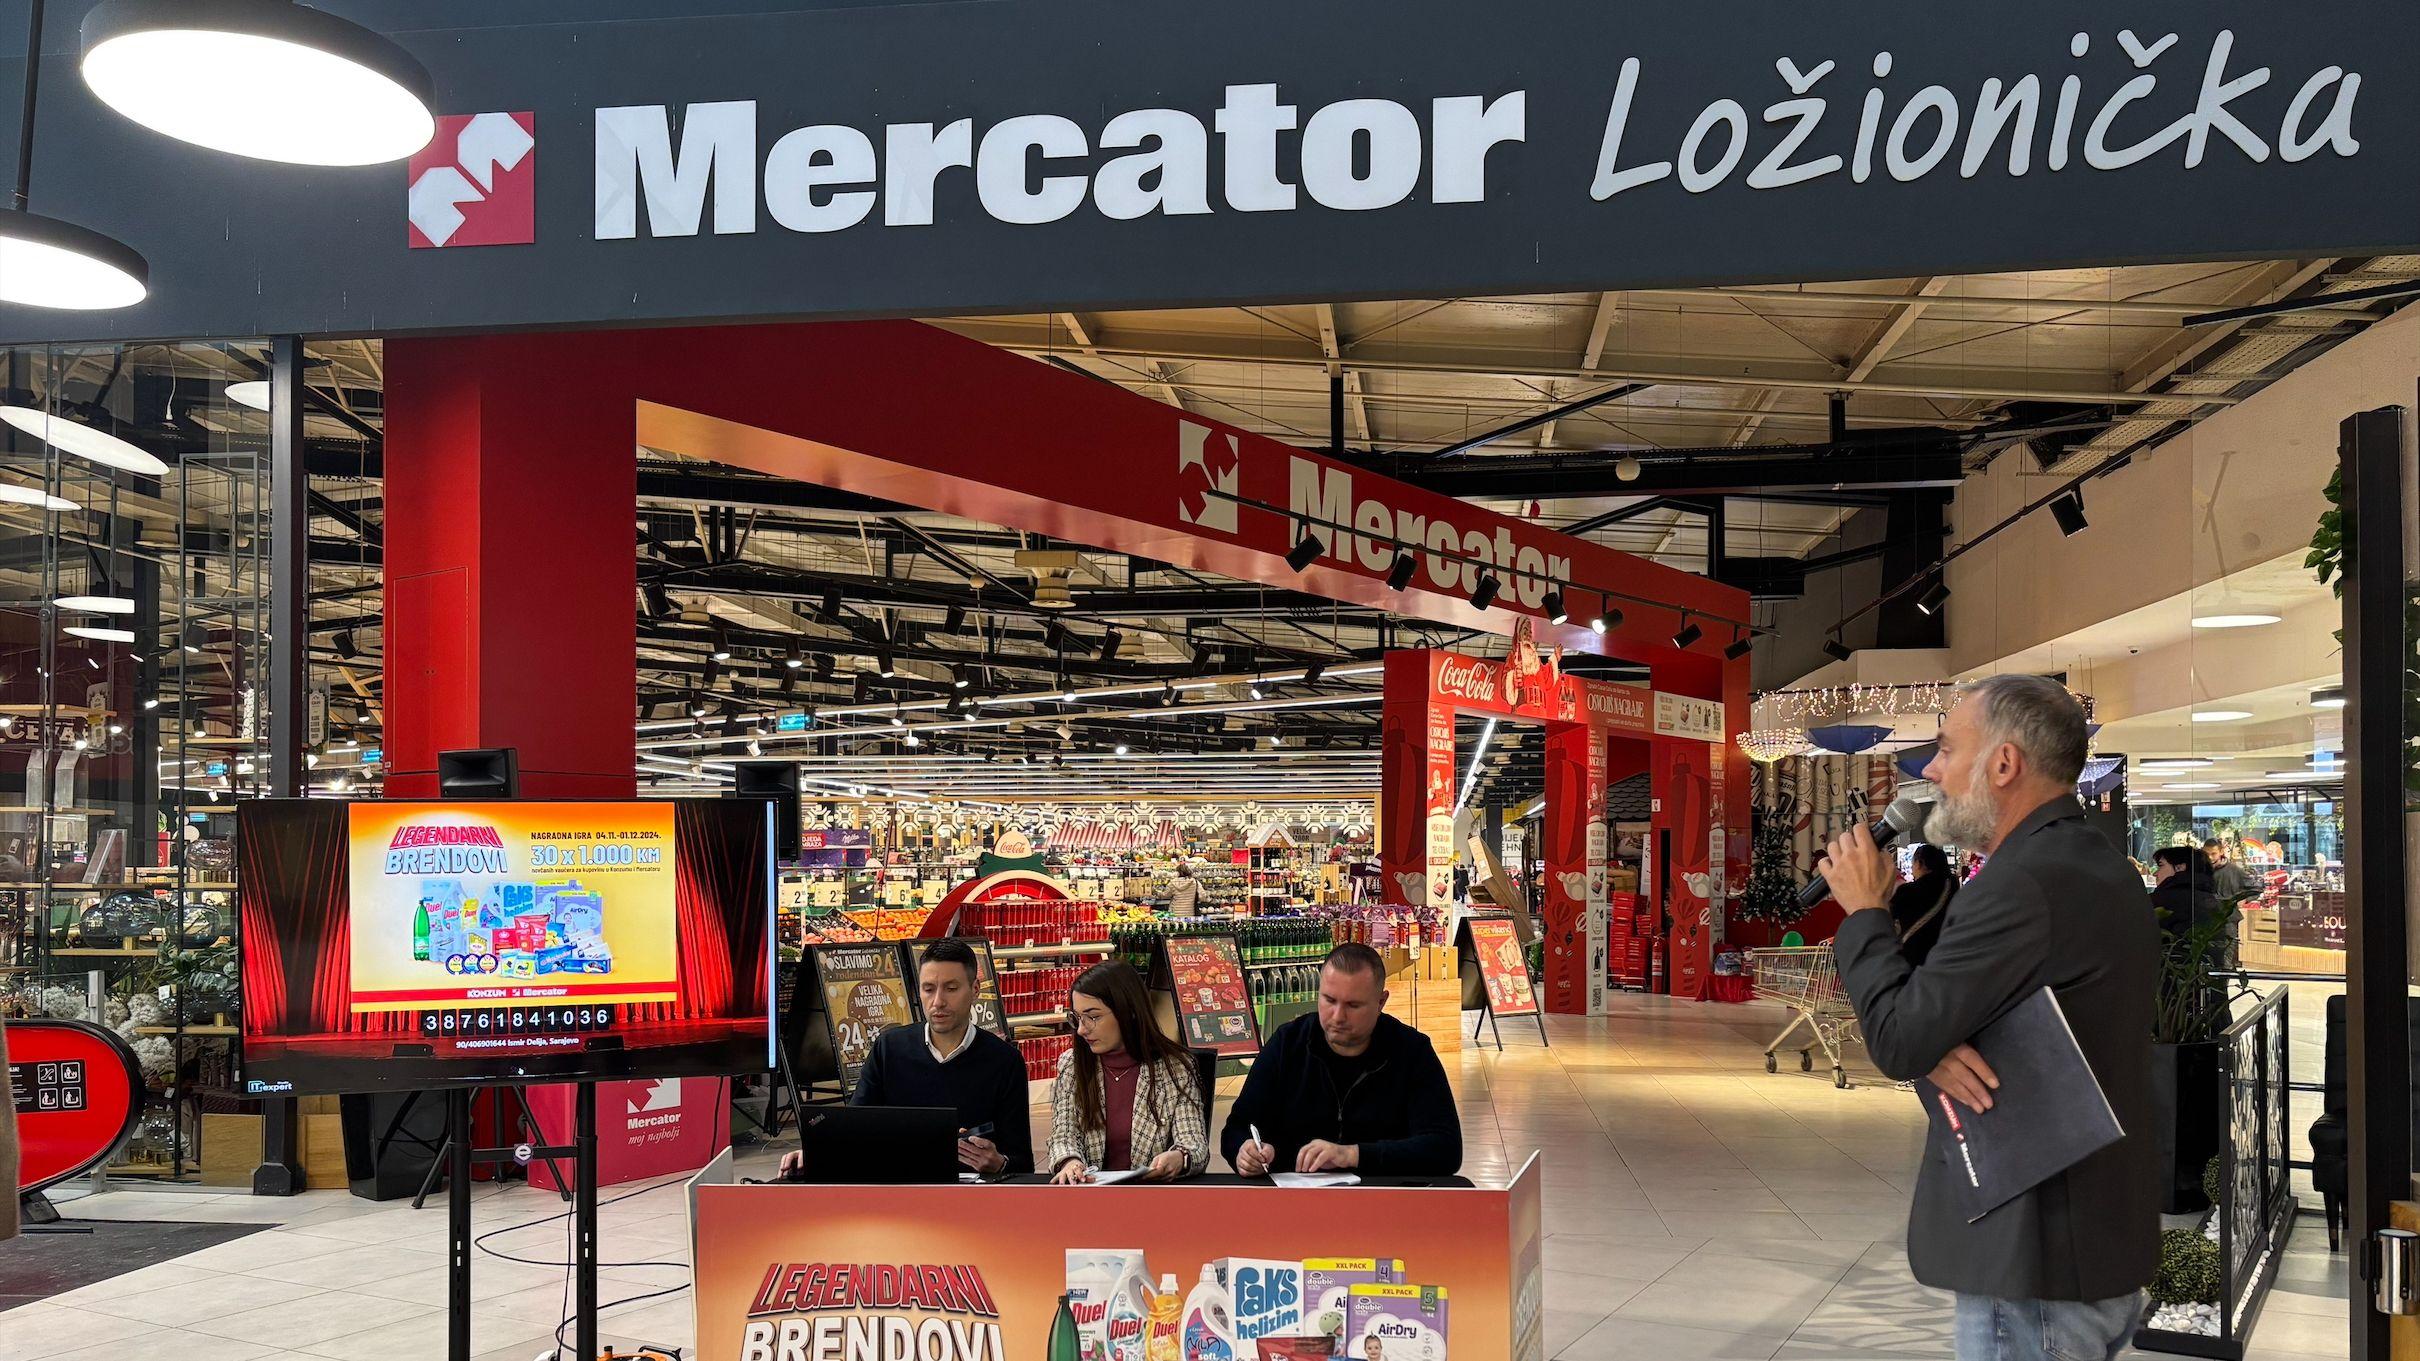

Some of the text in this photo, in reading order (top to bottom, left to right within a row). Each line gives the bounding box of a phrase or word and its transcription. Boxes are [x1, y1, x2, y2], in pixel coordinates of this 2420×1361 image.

[595, 29, 2361, 239] Mercator Ložionička
[1290, 455, 1571, 609] Mercator
[1438, 657, 1497, 702] Coca-Cola
[389, 826, 504, 849] LEGENDARNI
[531, 831, 572, 841] NAGRADNA
[574, 831, 593, 840] IGRA
[385, 849, 508, 875] BRENDOVI
[531, 844, 661, 865] 30 x 1.000 KM
[834, 953, 896, 977] SLAVIMO 24
[1172, 954, 1210, 964] KATALOG
[467, 988, 568, 998] KONZUM Mercator
[854, 994, 893, 1008] NAGRADNA
[858, 986, 883, 996] VELIKA
[426, 1010, 608, 1031] 38761841036
[867, 1006, 885, 1017] IGRA
[549, 1037, 579, 1046] Sarajevo
[839, 1022, 865, 1051] 24
[627, 1113, 681, 1130] Mercator
[628, 1126, 681, 1147] moj najbolji
[1960, 1142, 1980, 1188] Mercator
[1307, 1277, 1334, 1286] double
[1380, 1266, 1389, 1278] 4
[747, 1263, 999, 1318] LEGENDARNI
[1424, 1292, 1434, 1304] 5
[1072, 1300, 1107, 1325] Duel
[1355, 1303, 1383, 1312] double
[1109, 1317, 1142, 1341] Duel
[1153, 1320, 1180, 1338] Duel
[1236, 1309, 1298, 1340] helizim
[1379, 1324, 1417, 1338] AirDry
[741, 1316, 1006, 1361] BRENDOVI
[1198, 1352, 1216, 1361] soft
